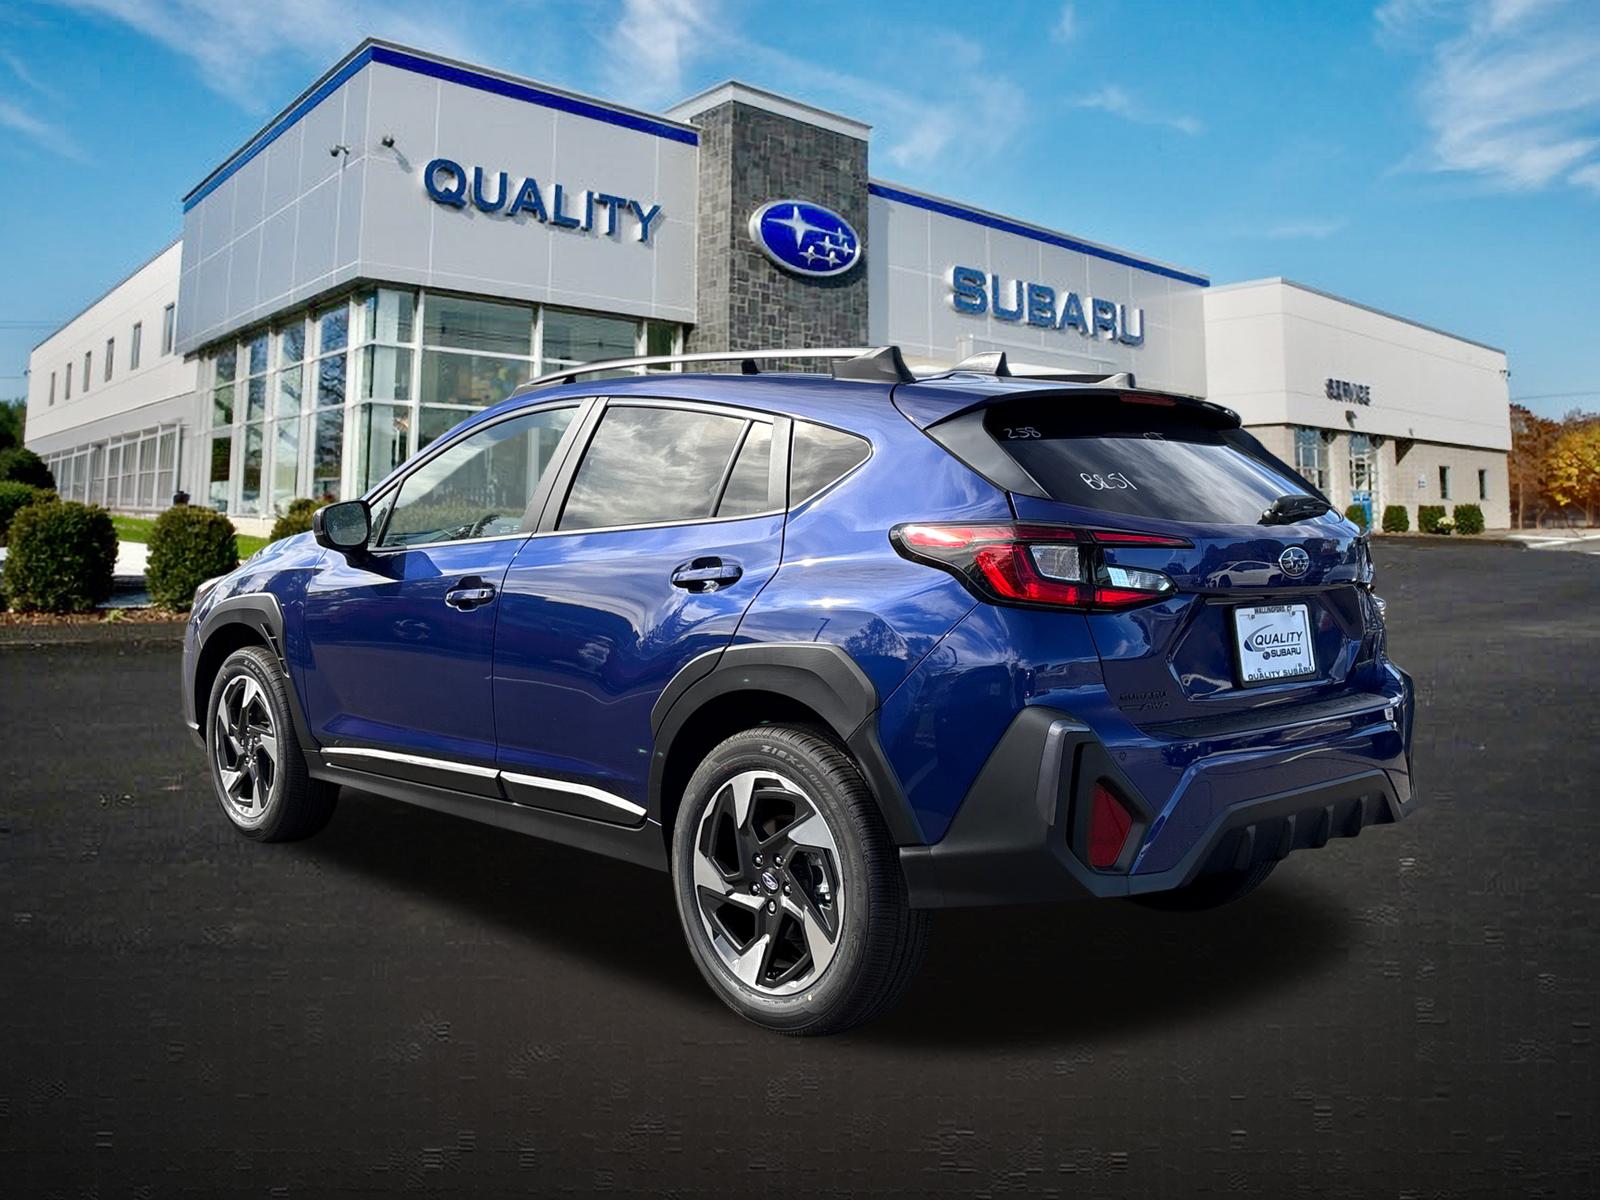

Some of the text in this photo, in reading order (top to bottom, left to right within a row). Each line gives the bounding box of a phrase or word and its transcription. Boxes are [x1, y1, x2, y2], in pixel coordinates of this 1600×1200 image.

[424, 157, 662, 243] QUALITY
[949, 265, 1145, 345] SUBARU
[1325, 378, 1371, 406] SERVICE
[1003, 426, 1041, 439] 258
[1254, 631, 1303, 646] QUALITY
[1270, 647, 1301, 658] SUBARU
[1248, 666, 1314, 680] QUALITY SUBARU
